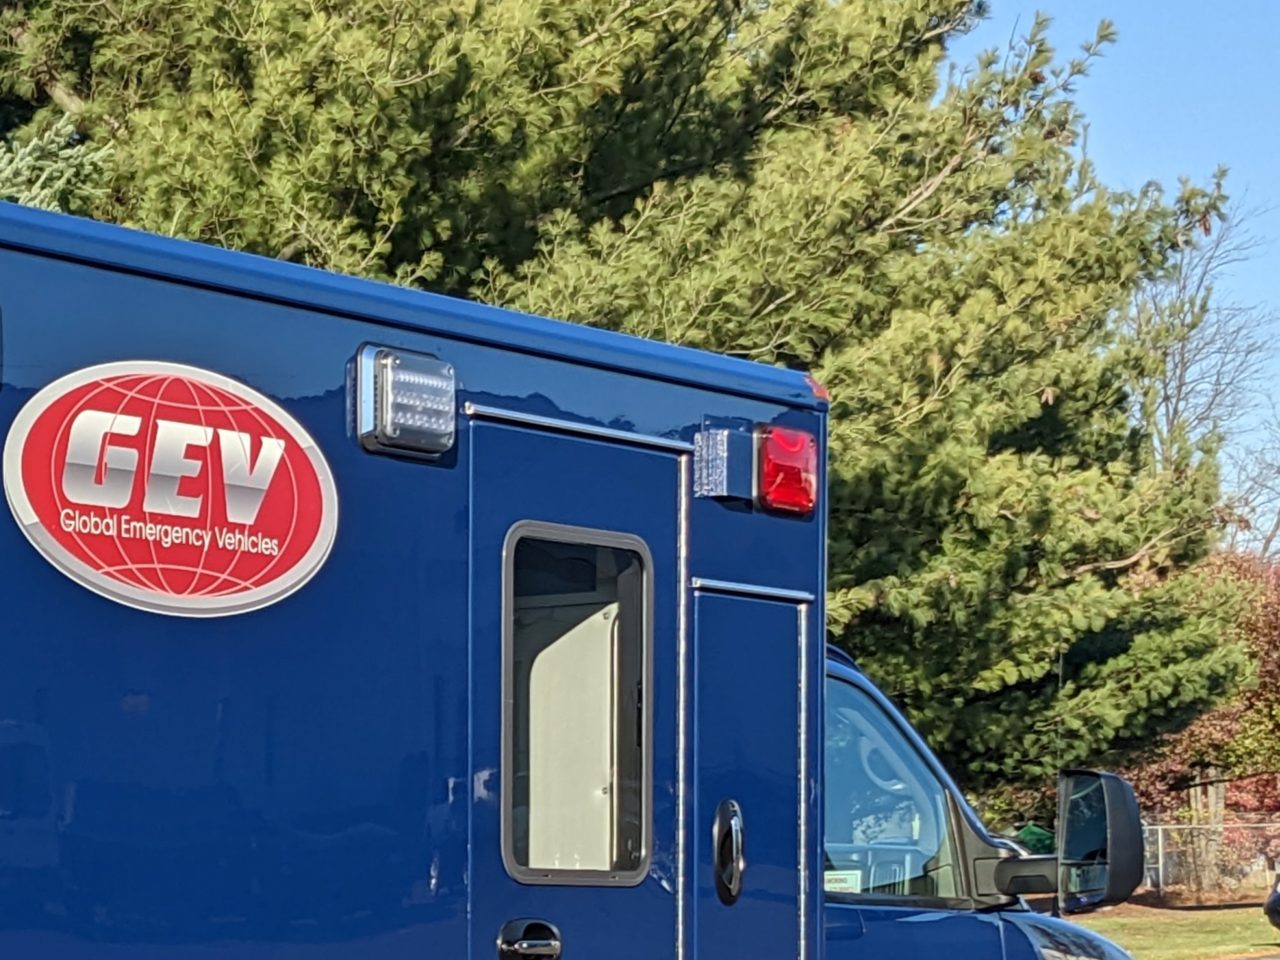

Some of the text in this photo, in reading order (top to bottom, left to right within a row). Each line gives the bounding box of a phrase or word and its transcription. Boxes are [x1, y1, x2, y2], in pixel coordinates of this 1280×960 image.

[62, 409, 286, 526] GEV
[60, 508, 279, 557] Global Emergency Vehicles
